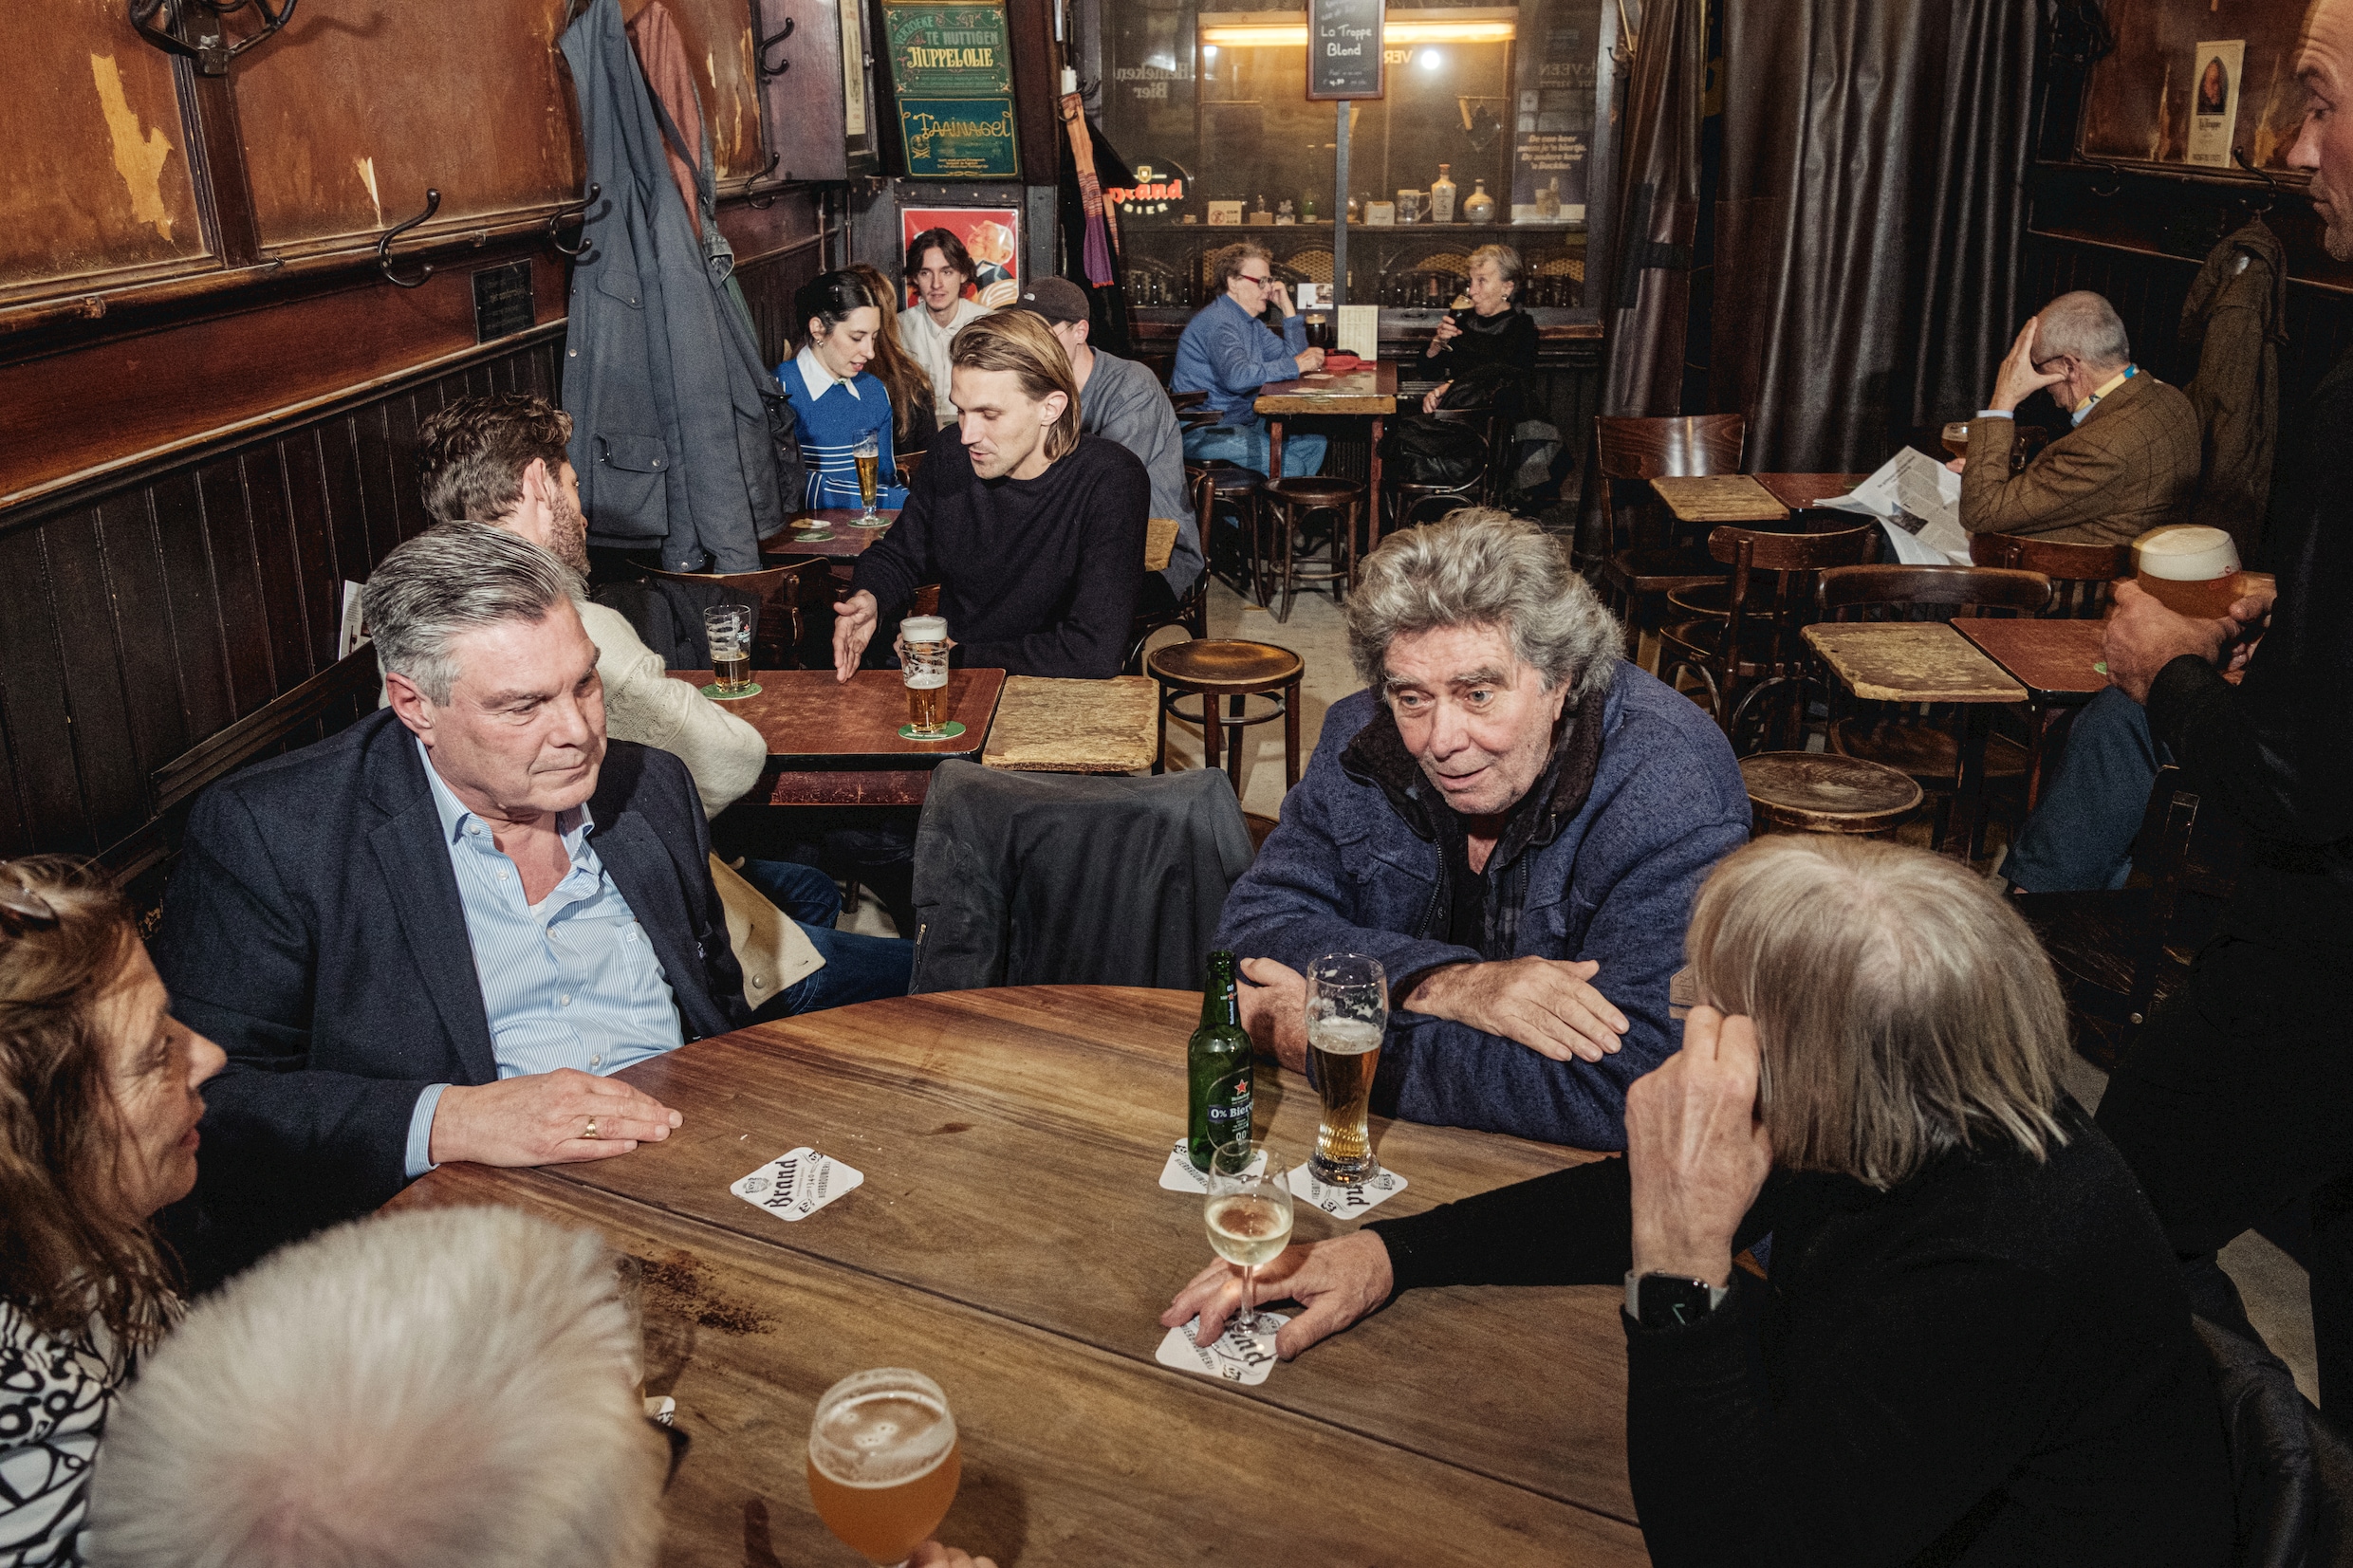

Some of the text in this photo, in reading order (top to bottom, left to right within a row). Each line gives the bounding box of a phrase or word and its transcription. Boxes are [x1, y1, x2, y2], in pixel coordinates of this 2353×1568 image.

[894, 15, 935, 45] VERZOEKE
[925, 31, 999, 46] TE NUTTIGEN
[1123, 202, 1168, 214] BIER
[1211, 1108, 1228, 1118] 0%
[763, 1158, 798, 1208] Brand
